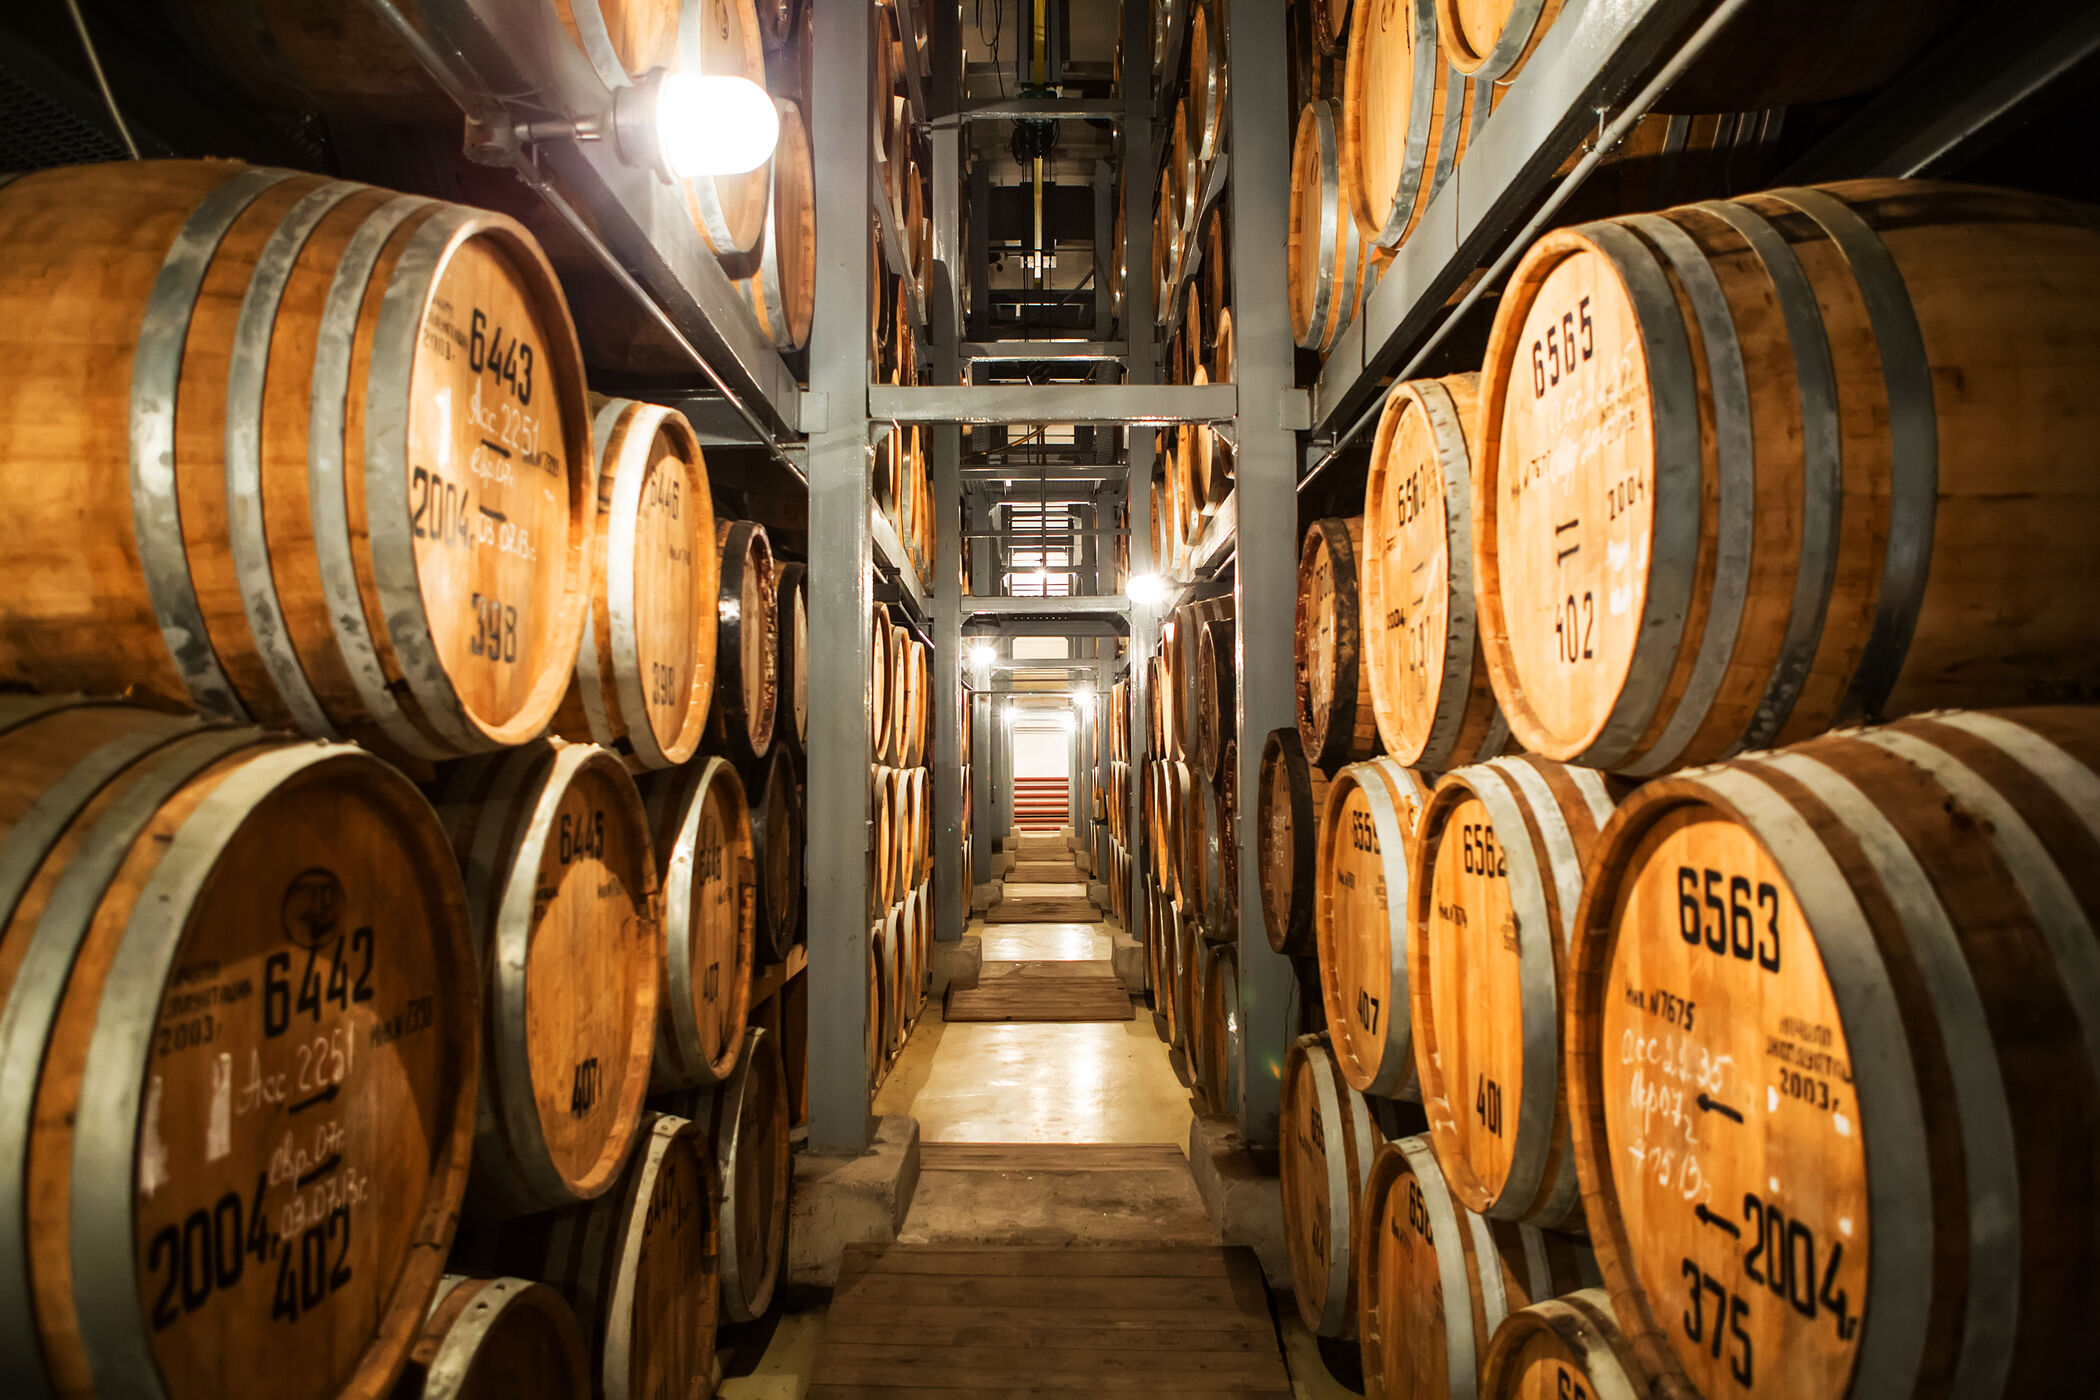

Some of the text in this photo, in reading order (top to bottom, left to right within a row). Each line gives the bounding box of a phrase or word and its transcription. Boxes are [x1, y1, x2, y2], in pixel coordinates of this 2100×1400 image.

[470, 308, 533, 406] 6443
[1533, 295, 1594, 400] 6565
[501, 404, 540, 457] 2251
[472, 593, 517, 663] 398
[560, 811, 604, 866] 6445
[1463, 824, 1508, 879] 6562
[1678, 866, 1780, 975] 6563
[264, 926, 375, 1038] 6442
[1357, 987, 1380, 1036] 407
[1476, 1073, 1502, 1139] 401
[272, 1204, 352, 1324] 402
[1682, 1257, 1752, 1390] 375
